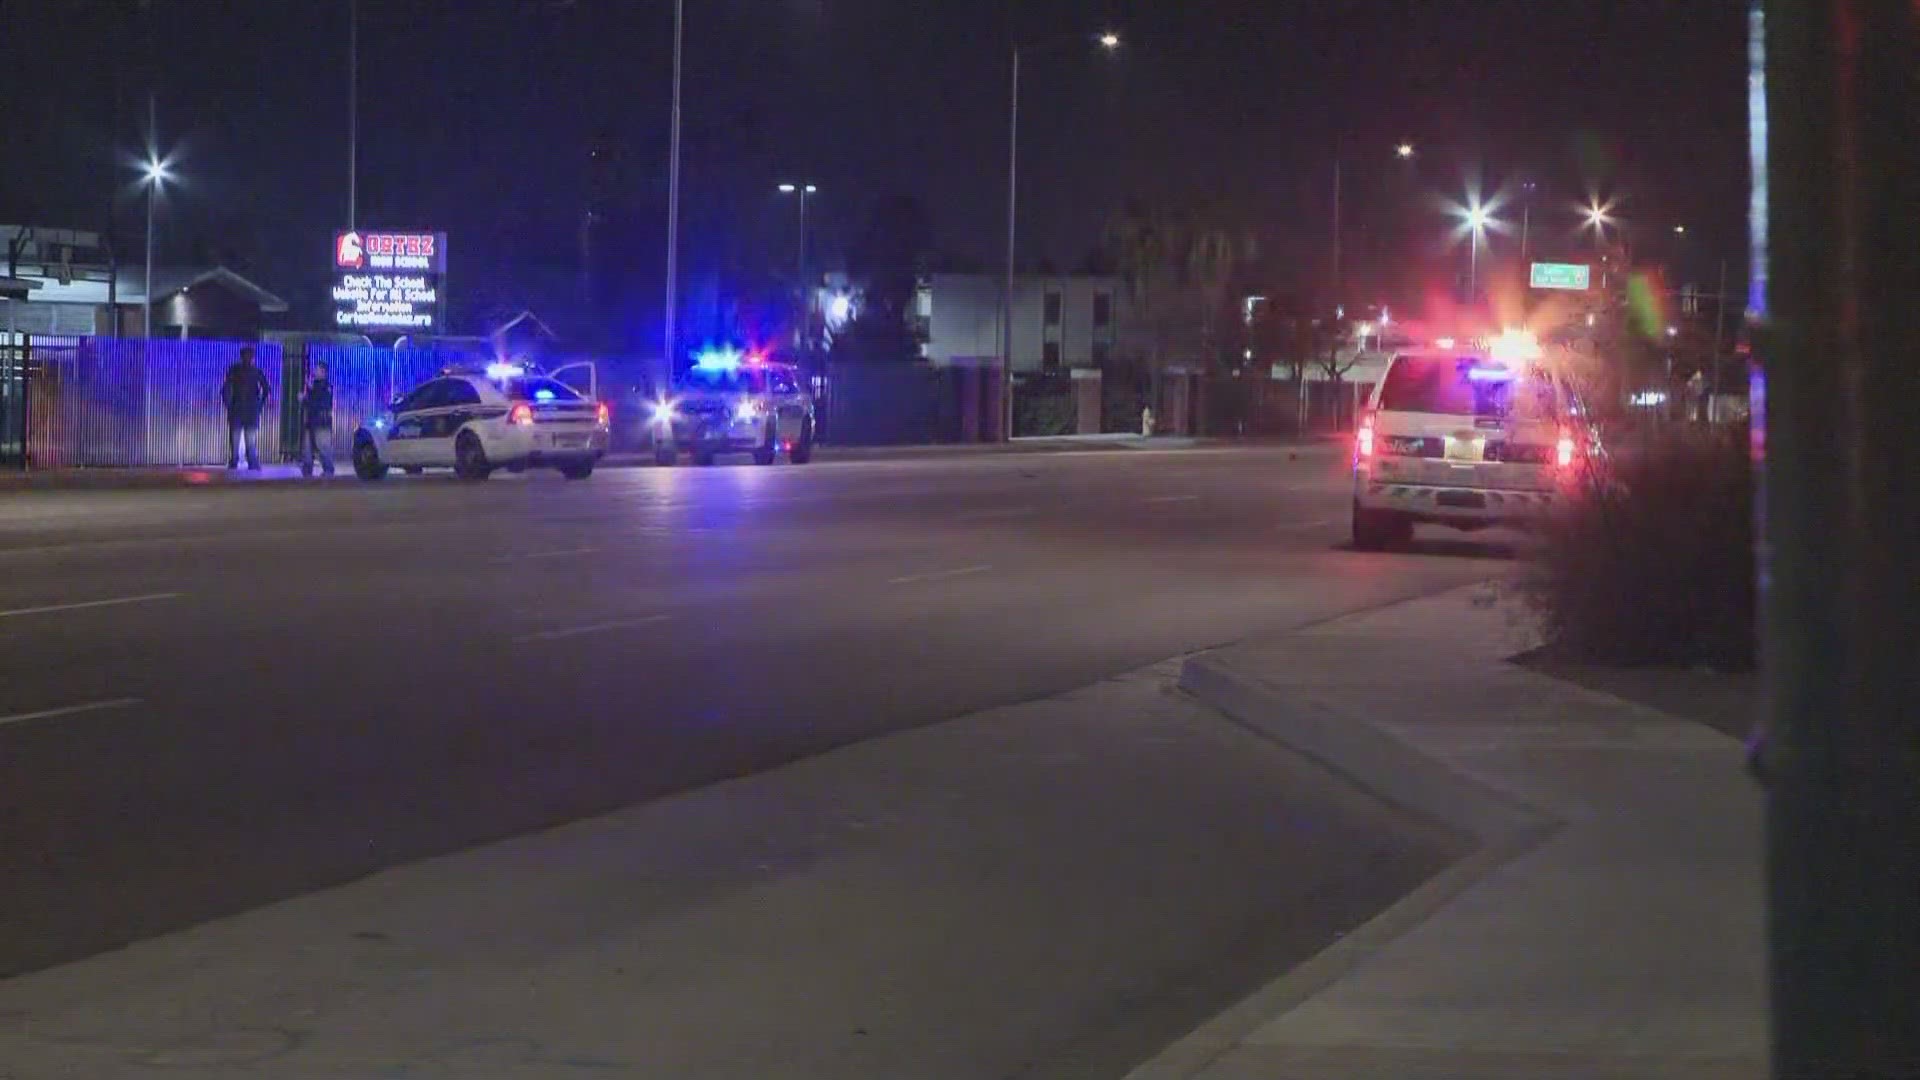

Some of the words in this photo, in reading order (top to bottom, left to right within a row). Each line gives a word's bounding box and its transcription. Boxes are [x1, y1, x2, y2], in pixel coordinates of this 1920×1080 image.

[374, 275, 392, 289] The
[394, 276, 425, 290] School
[405, 289, 436, 302] School
